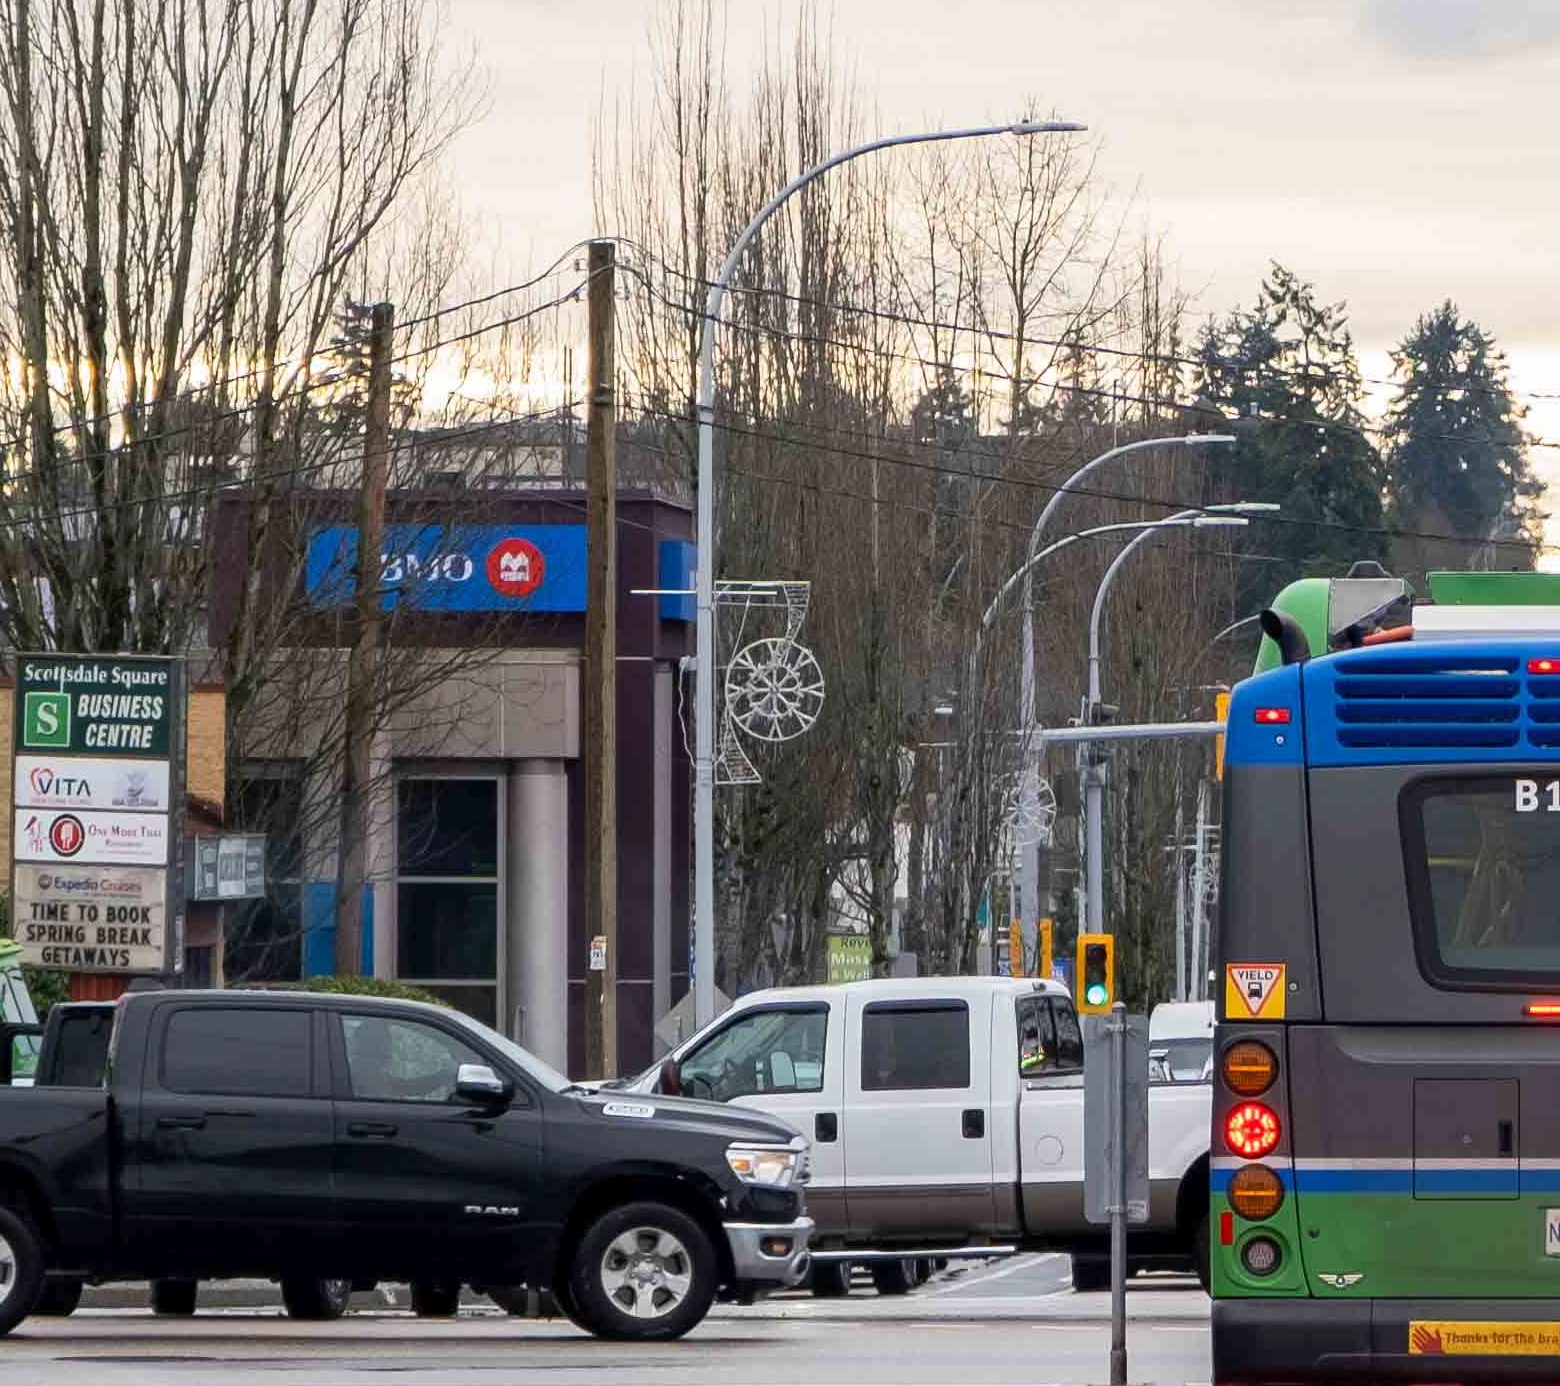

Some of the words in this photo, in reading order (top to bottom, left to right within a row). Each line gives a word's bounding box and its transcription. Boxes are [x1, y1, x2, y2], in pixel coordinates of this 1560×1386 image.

[24, 664, 108, 684] Scottsdale
[112, 666, 168, 689] Square
[36, 701, 59, 735] S
[77, 694, 164, 721] BUSINESS
[84, 723, 153, 748] CENTRE
[38, 777, 92, 798] VITA
[30, 903, 70, 922] TIME
[77, 904, 99, 922] TO
[106, 906, 151, 924] BOOK
[26, 924, 86, 943] SPRING
[96, 926, 152, 945] BREAK
[41, 947, 130, 966] GETAWAYS
[1237, 969, 1274, 981] YIELD
[464, 1205, 519, 1216] RAM
[1446, 1331, 1488, 1344] Thanks
[1492, 1331, 1510, 1345] for
[1511, 1331, 1534, 1345] the
